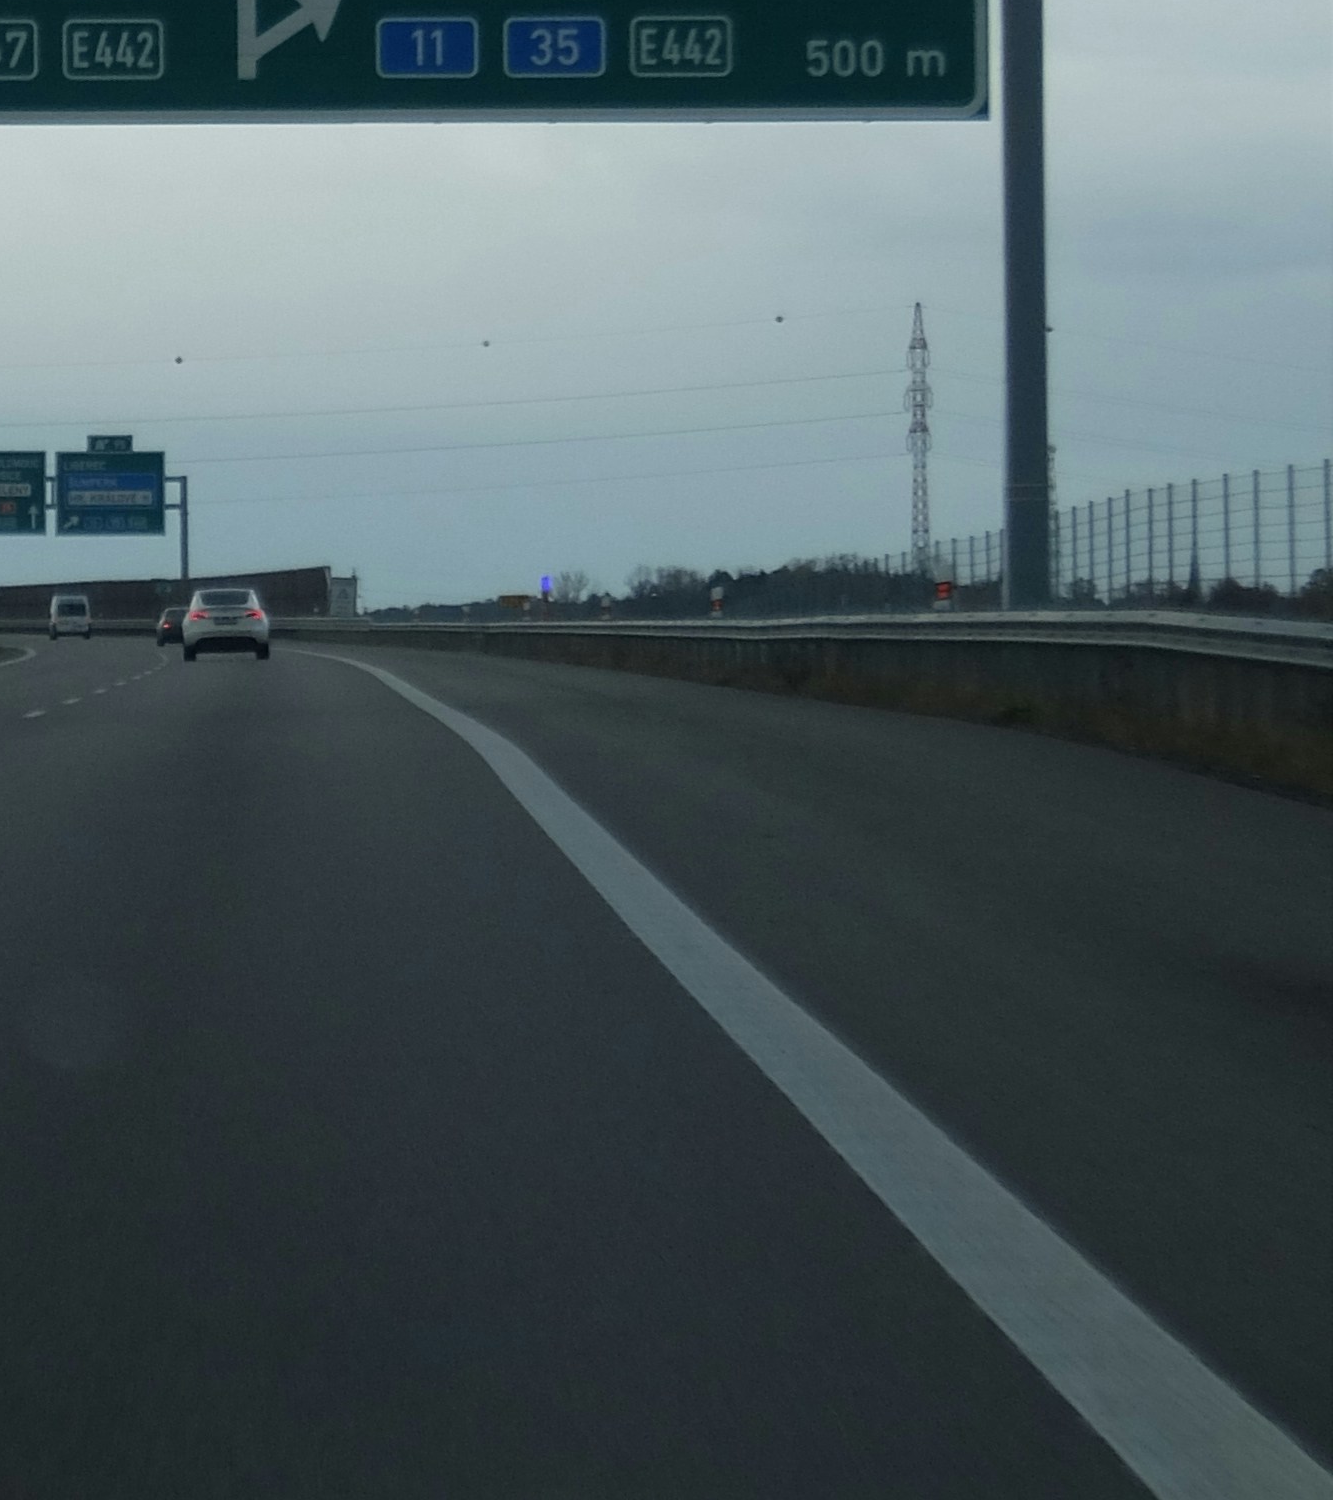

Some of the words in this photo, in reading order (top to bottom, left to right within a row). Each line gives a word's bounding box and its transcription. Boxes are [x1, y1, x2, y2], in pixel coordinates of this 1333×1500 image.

[72, 31, 155, 69] E442
[410, 28, 445, 66] 11
[530, 28, 580, 66] 35
[639, 28, 723, 66] E442
[805, 40, 884, 78] 500
[906, 48, 947, 77] m
